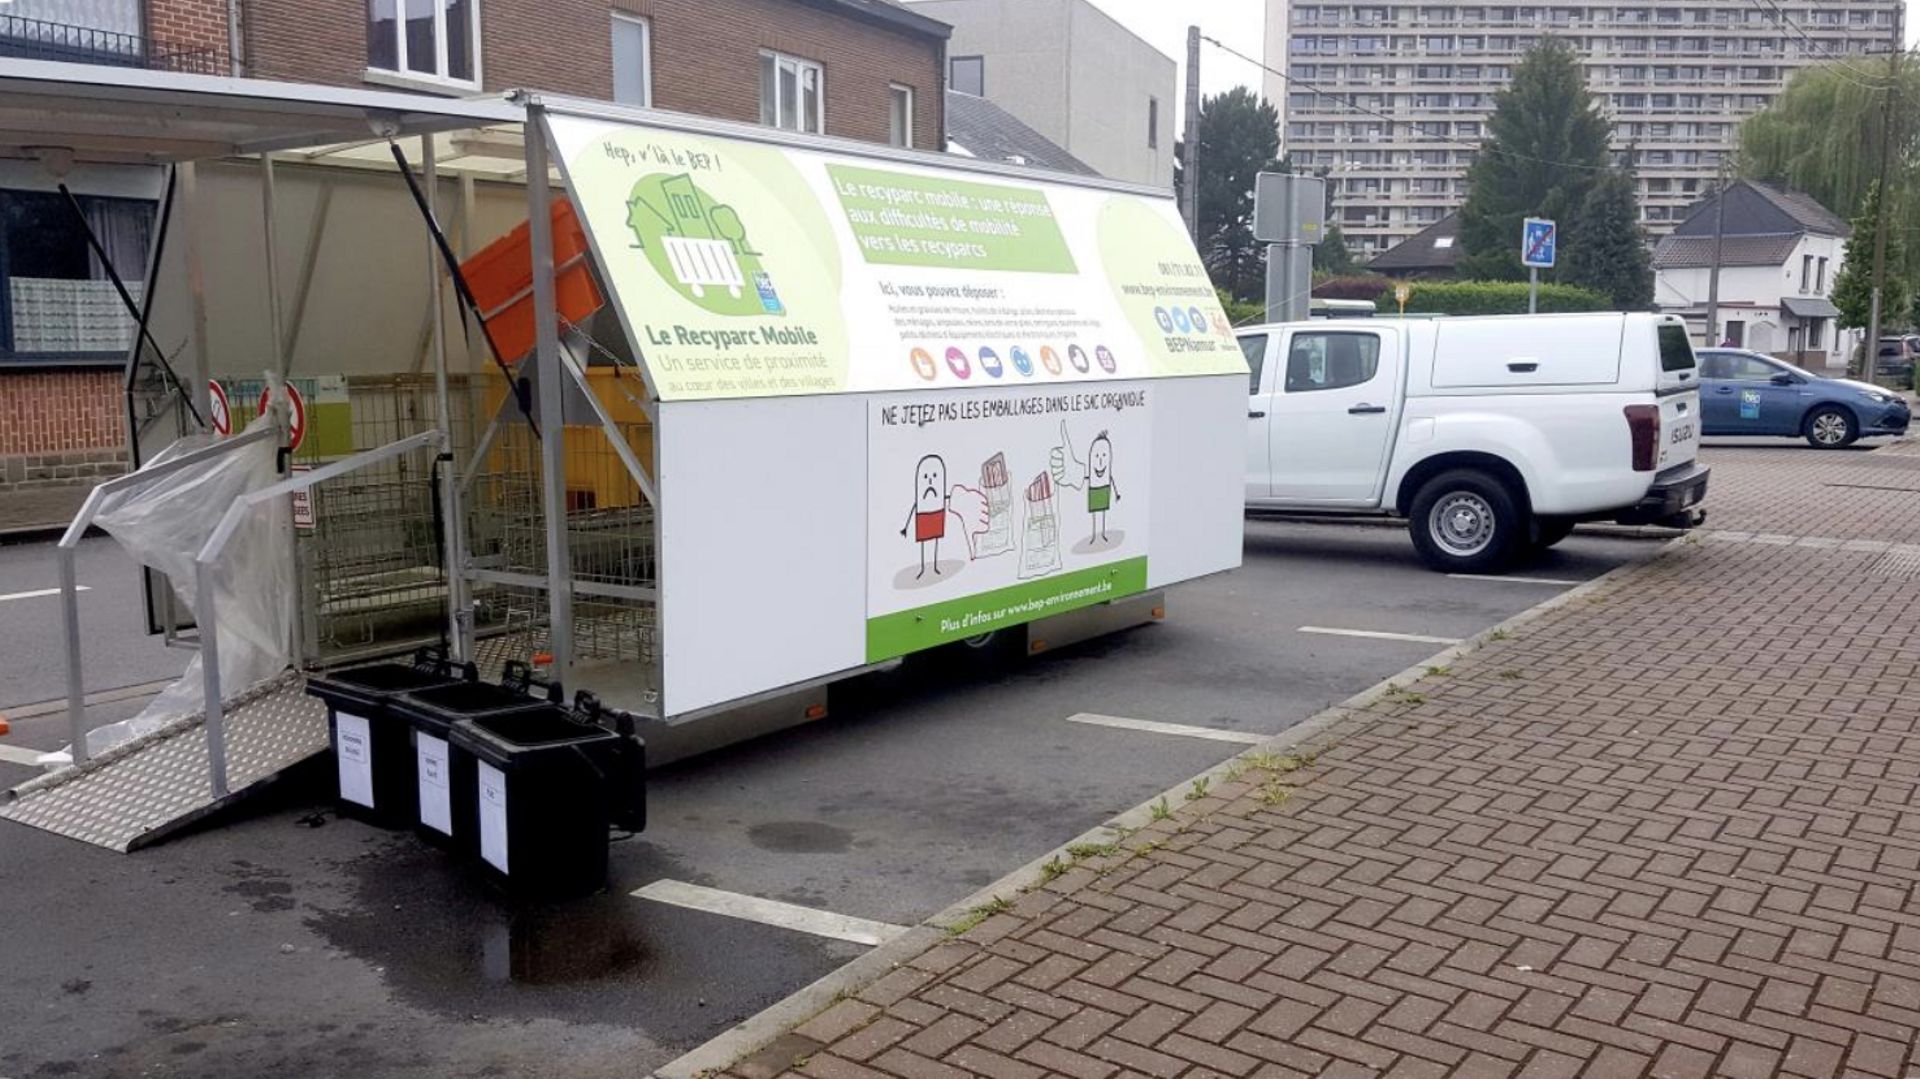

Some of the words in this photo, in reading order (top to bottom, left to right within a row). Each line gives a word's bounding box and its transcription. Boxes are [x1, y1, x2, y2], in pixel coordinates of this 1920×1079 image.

[671, 149, 687, 165] le
[686, 150, 711, 170] BEP
[714, 154, 722, 172] !
[834, 177, 857, 196] Le
[858, 183, 923, 205] recyparc
[924, 188, 969, 208] mobile
[979, 197, 1004, 212] une
[1005, 197, 1052, 218] réponse
[848, 209, 876, 225] aux
[880, 208, 949, 231] difficultés
[951, 217, 968, 232] de
[969, 216, 1021, 236] mobilité
[859, 236, 895, 251] vers
[895, 234, 919, 252] les
[921, 241, 987, 259] recyparcs
[878, 281, 899, 297] Ici,
[899, 285, 926, 297] vous
[926, 285, 960, 299] pouvez
[962, 285, 998, 300] déposer
[644, 325, 672, 345] Le
[673, 325, 760, 350] Recyparc
[759, 326, 818, 345] Mobile
[658, 356, 684, 372] Un
[686, 355, 740, 371] service
[744, 353, 762, 370] de
[764, 352, 829, 372] proximité
[882, 405, 898, 426] NE
[900, 403, 935, 427] JETEZ
[938, 402, 958, 421] PAS
[960, 400, 980, 419] LES
[983, 397, 1043, 418] EMBALLAGES
[1045, 395, 1069, 413] DANS
[1071, 394, 1082, 412] LE
[1084, 393, 1099, 411] SAC
[1102, 390, 1145, 412] ORGANIQUE
[1671, 423, 1695, 444] ISUZU
[940, 617, 960, 633] Plus
[962, 611, 992, 628] d'infos
[993, 608, 1007, 620] sur
[1007, 581, 1113, 615] www.bep-environnement.be
